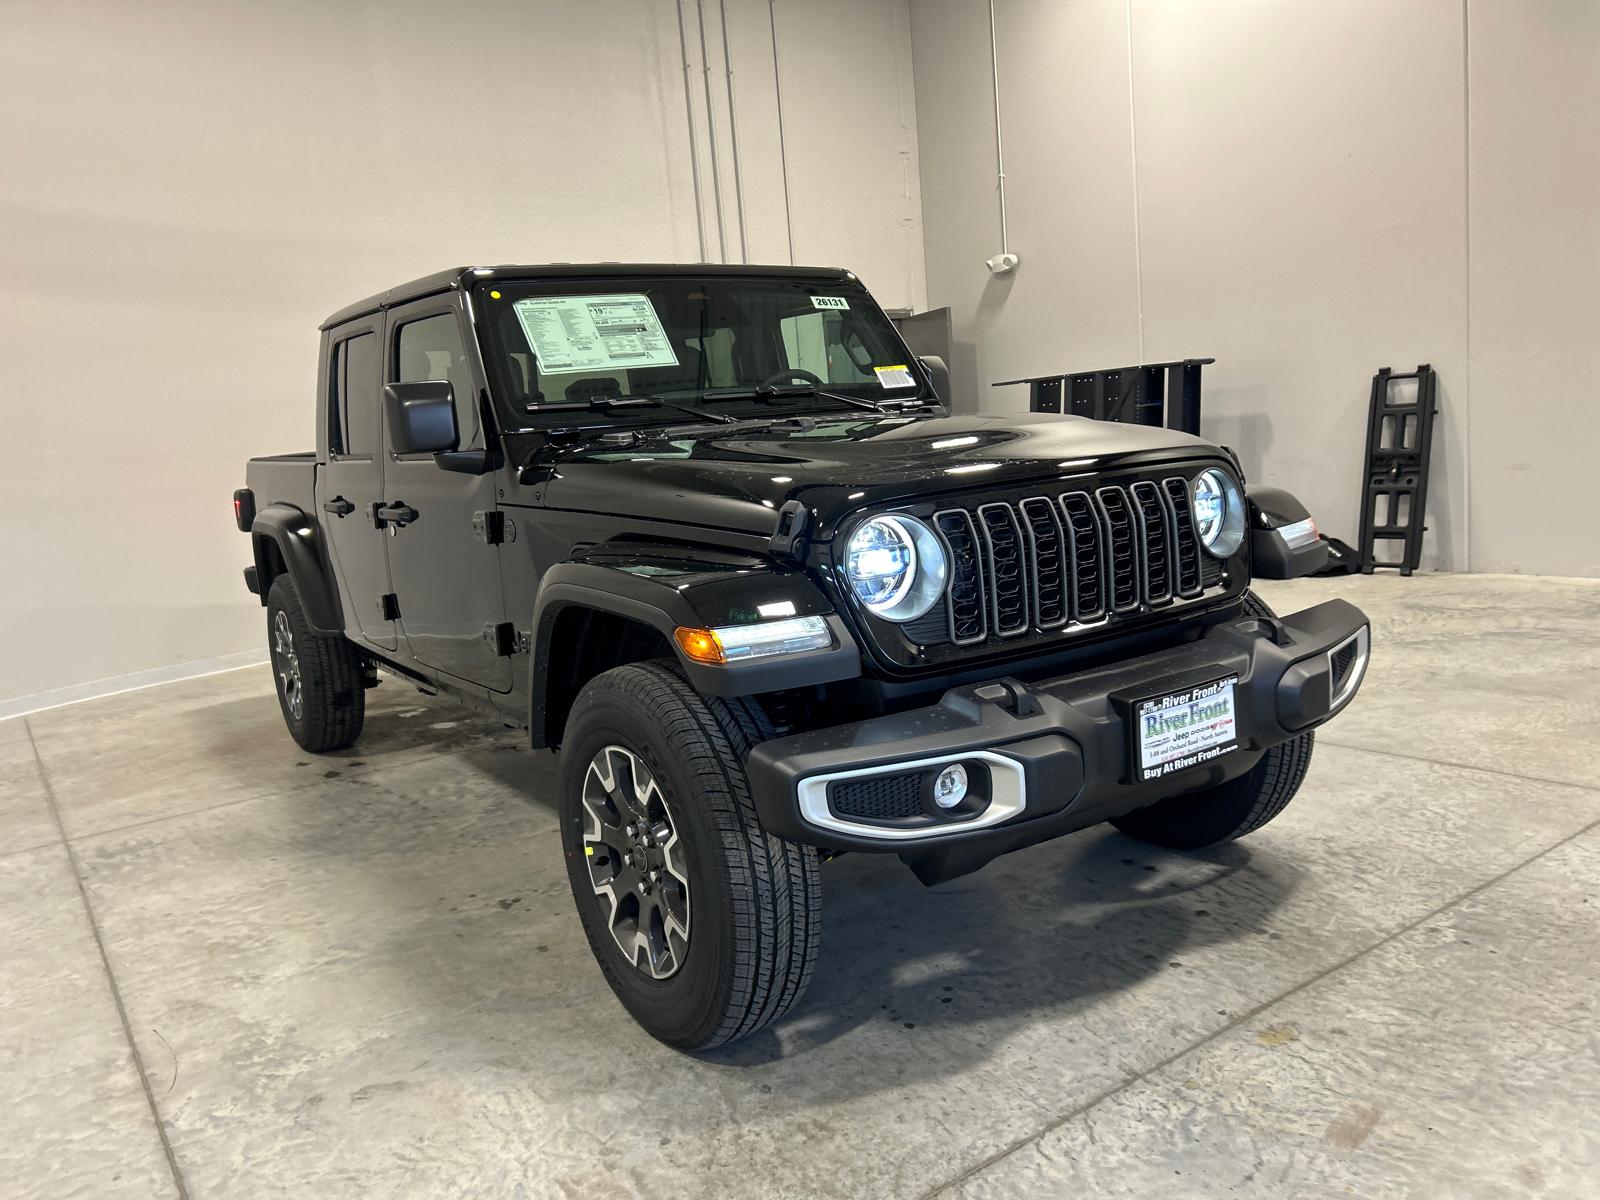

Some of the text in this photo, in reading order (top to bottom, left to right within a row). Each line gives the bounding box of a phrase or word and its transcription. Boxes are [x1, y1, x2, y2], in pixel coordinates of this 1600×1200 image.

[815, 298, 844, 306] 26131
[1162, 684, 1218, 709] River Front
[1172, 731, 1190, 742] Jeep
[1160, 746, 1169, 755] and
[1168, 740, 1187, 753] Orchard
[1143, 767, 1162, 779] Buy
[1163, 762, 1175, 774] At
[1175, 757, 1197, 769] River
